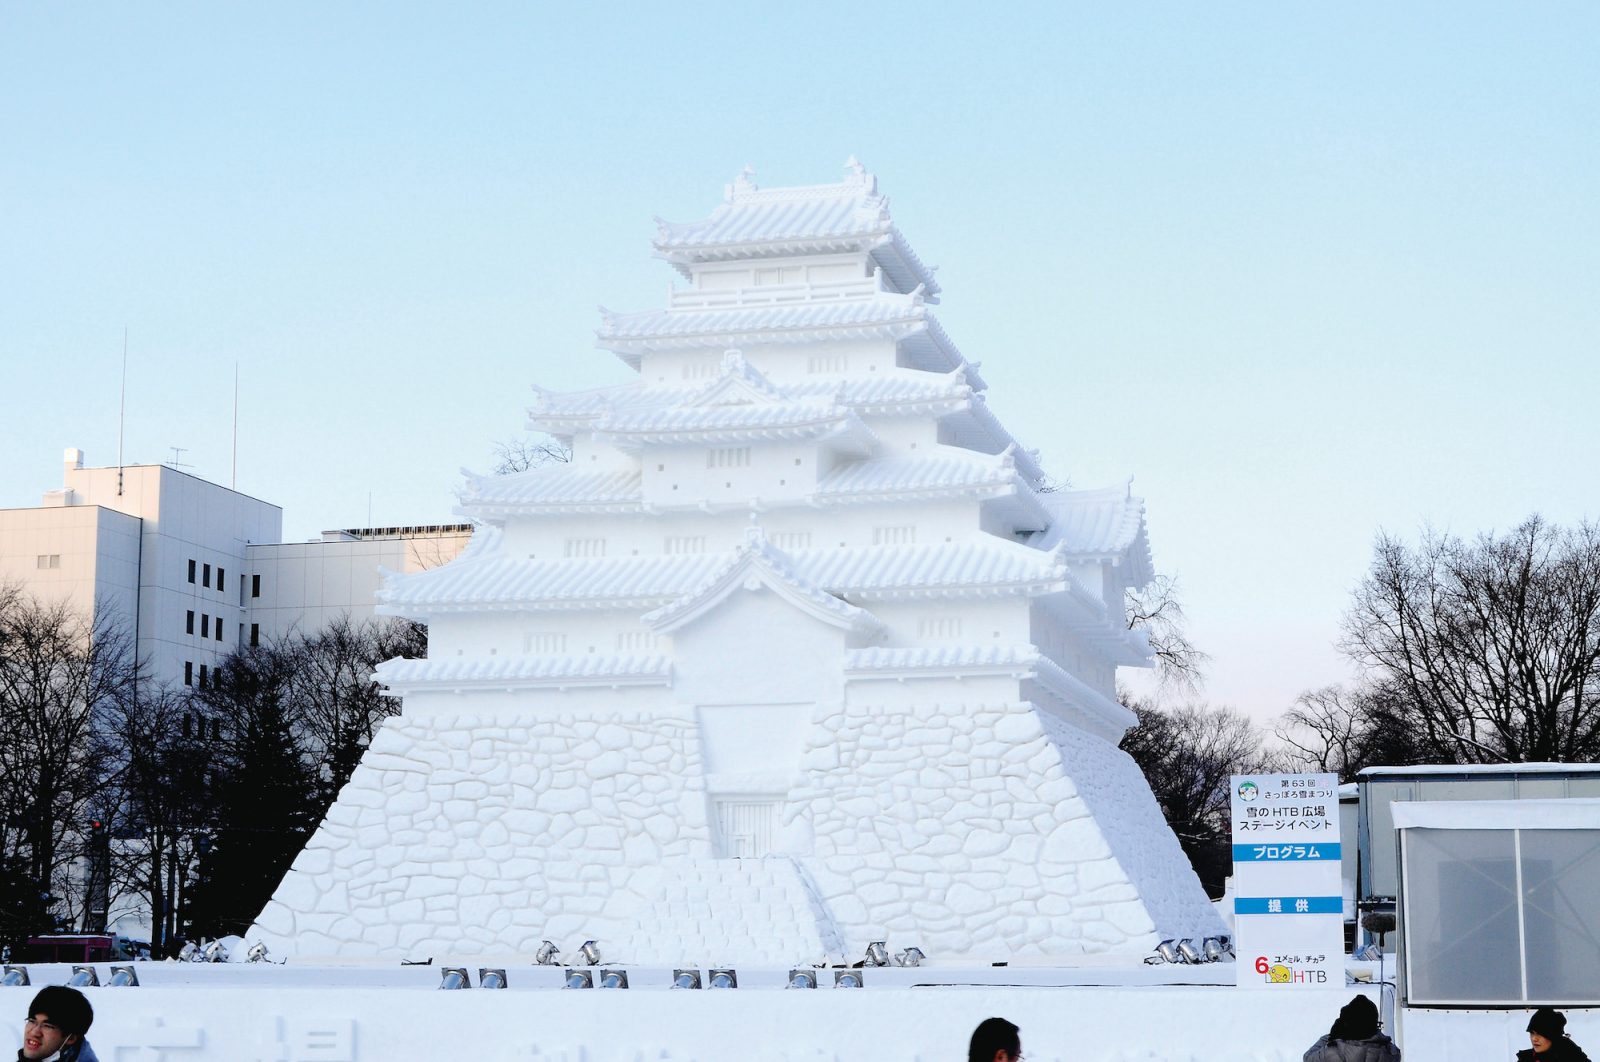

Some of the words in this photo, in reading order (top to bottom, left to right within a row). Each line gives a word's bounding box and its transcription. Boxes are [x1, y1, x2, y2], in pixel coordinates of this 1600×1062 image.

[1246, 805, 1326, 818] 雪のHTB広場
[1239, 820, 1332, 831] ステージイベント
[1253, 845, 1321, 859] プログラム
[1268, 899, 1309, 912] 提供
[1255, 956, 1269, 974] 6
[1294, 970, 1327, 983] HTB
